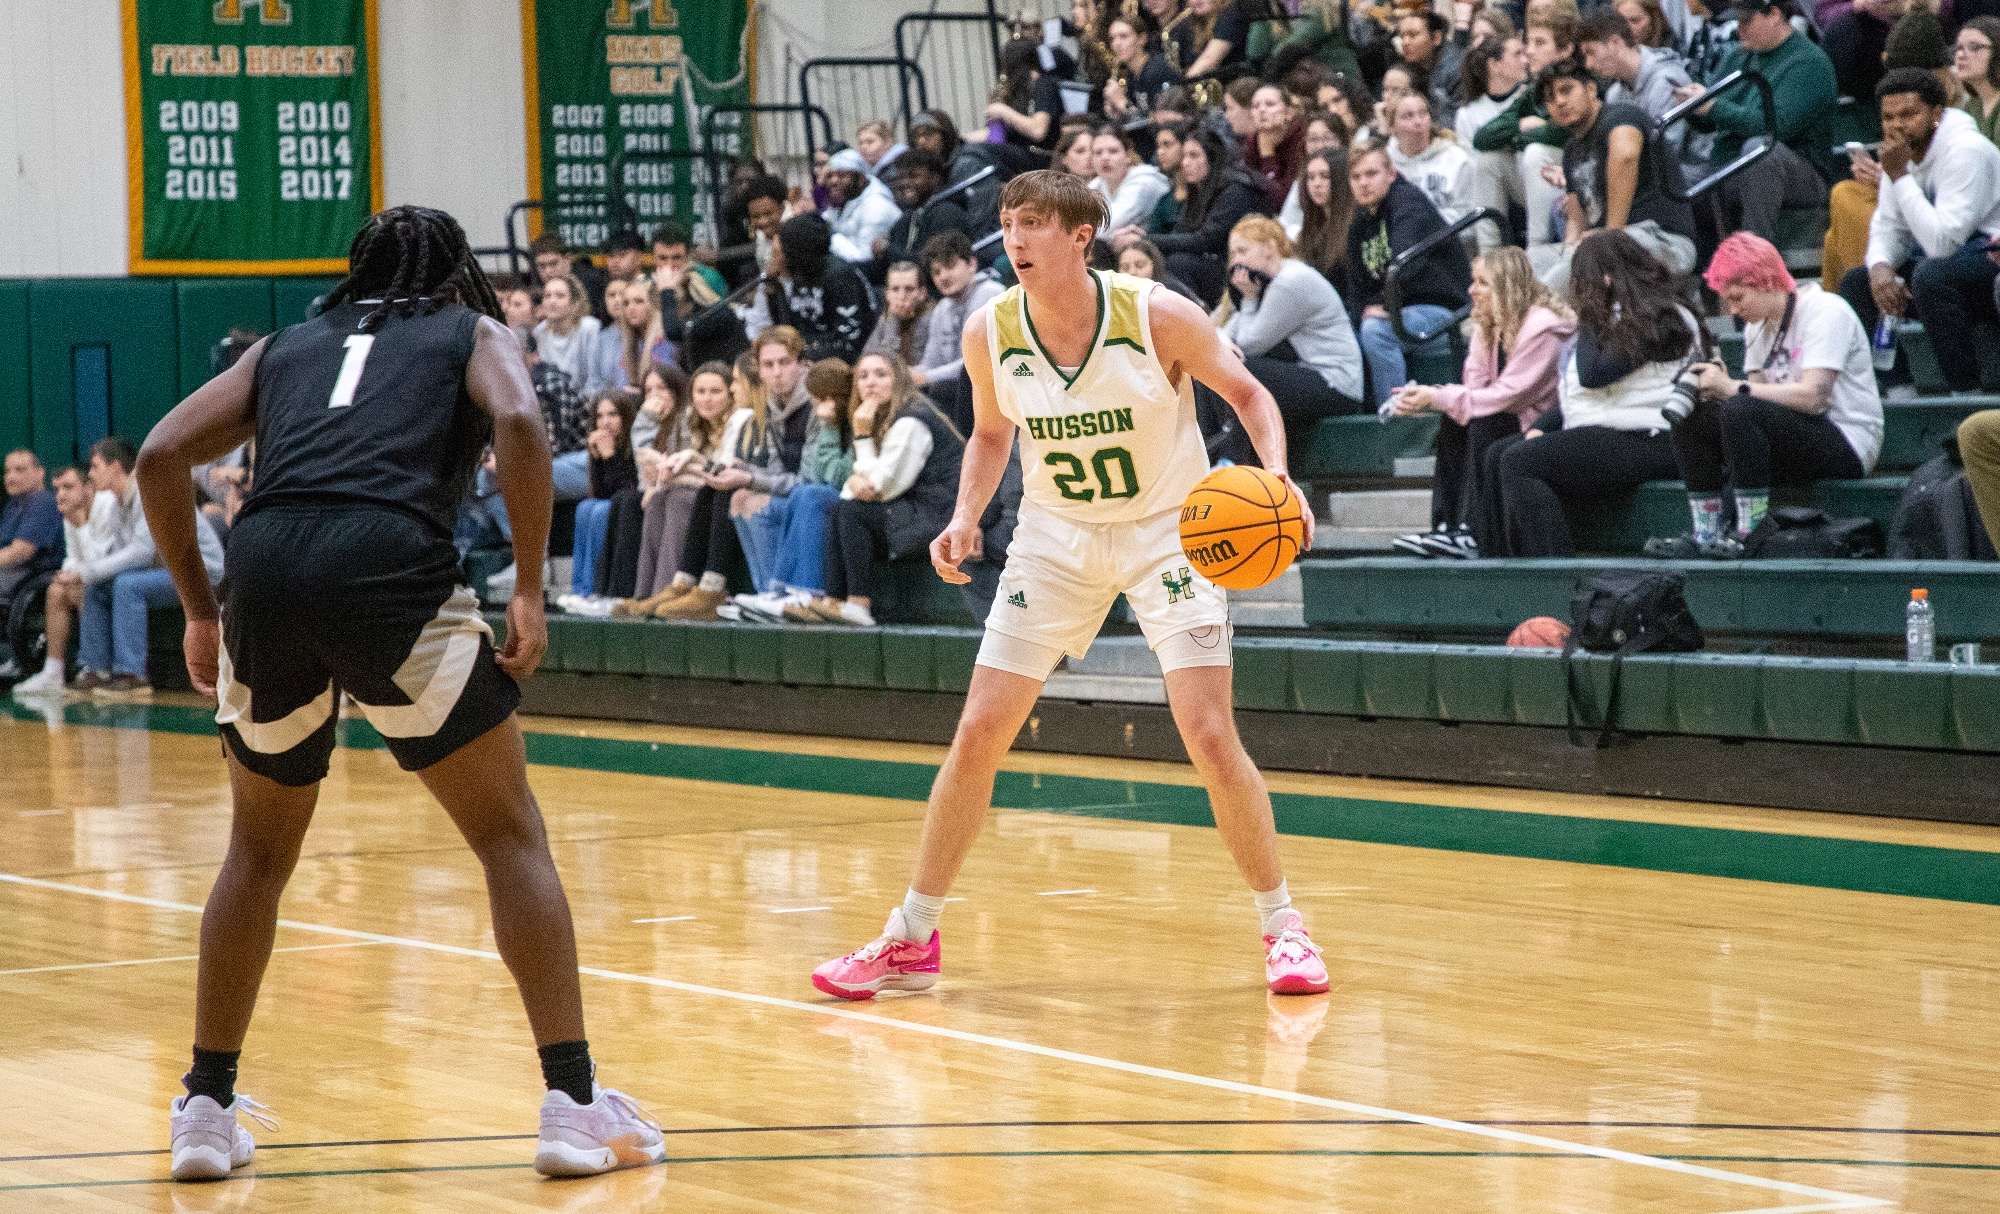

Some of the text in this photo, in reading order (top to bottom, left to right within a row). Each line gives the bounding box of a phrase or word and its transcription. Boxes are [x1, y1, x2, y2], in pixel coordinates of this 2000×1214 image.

[152, 44, 355, 77] FIELD HOCKEY
[159, 100, 350, 132] 2009 2010
[552, 103, 605, 128] 2007
[168, 135, 351, 167] 2011 2014
[554, 133, 607, 157] 2010
[165, 169, 351, 201] 2015 2017
[556, 163, 608, 187] 2013
[328, 334, 375, 409] 1
[1026, 406, 1136, 441] HUSSON
[1044, 446, 1140, 503] 20
[1183, 539, 1240, 567] Wilso
